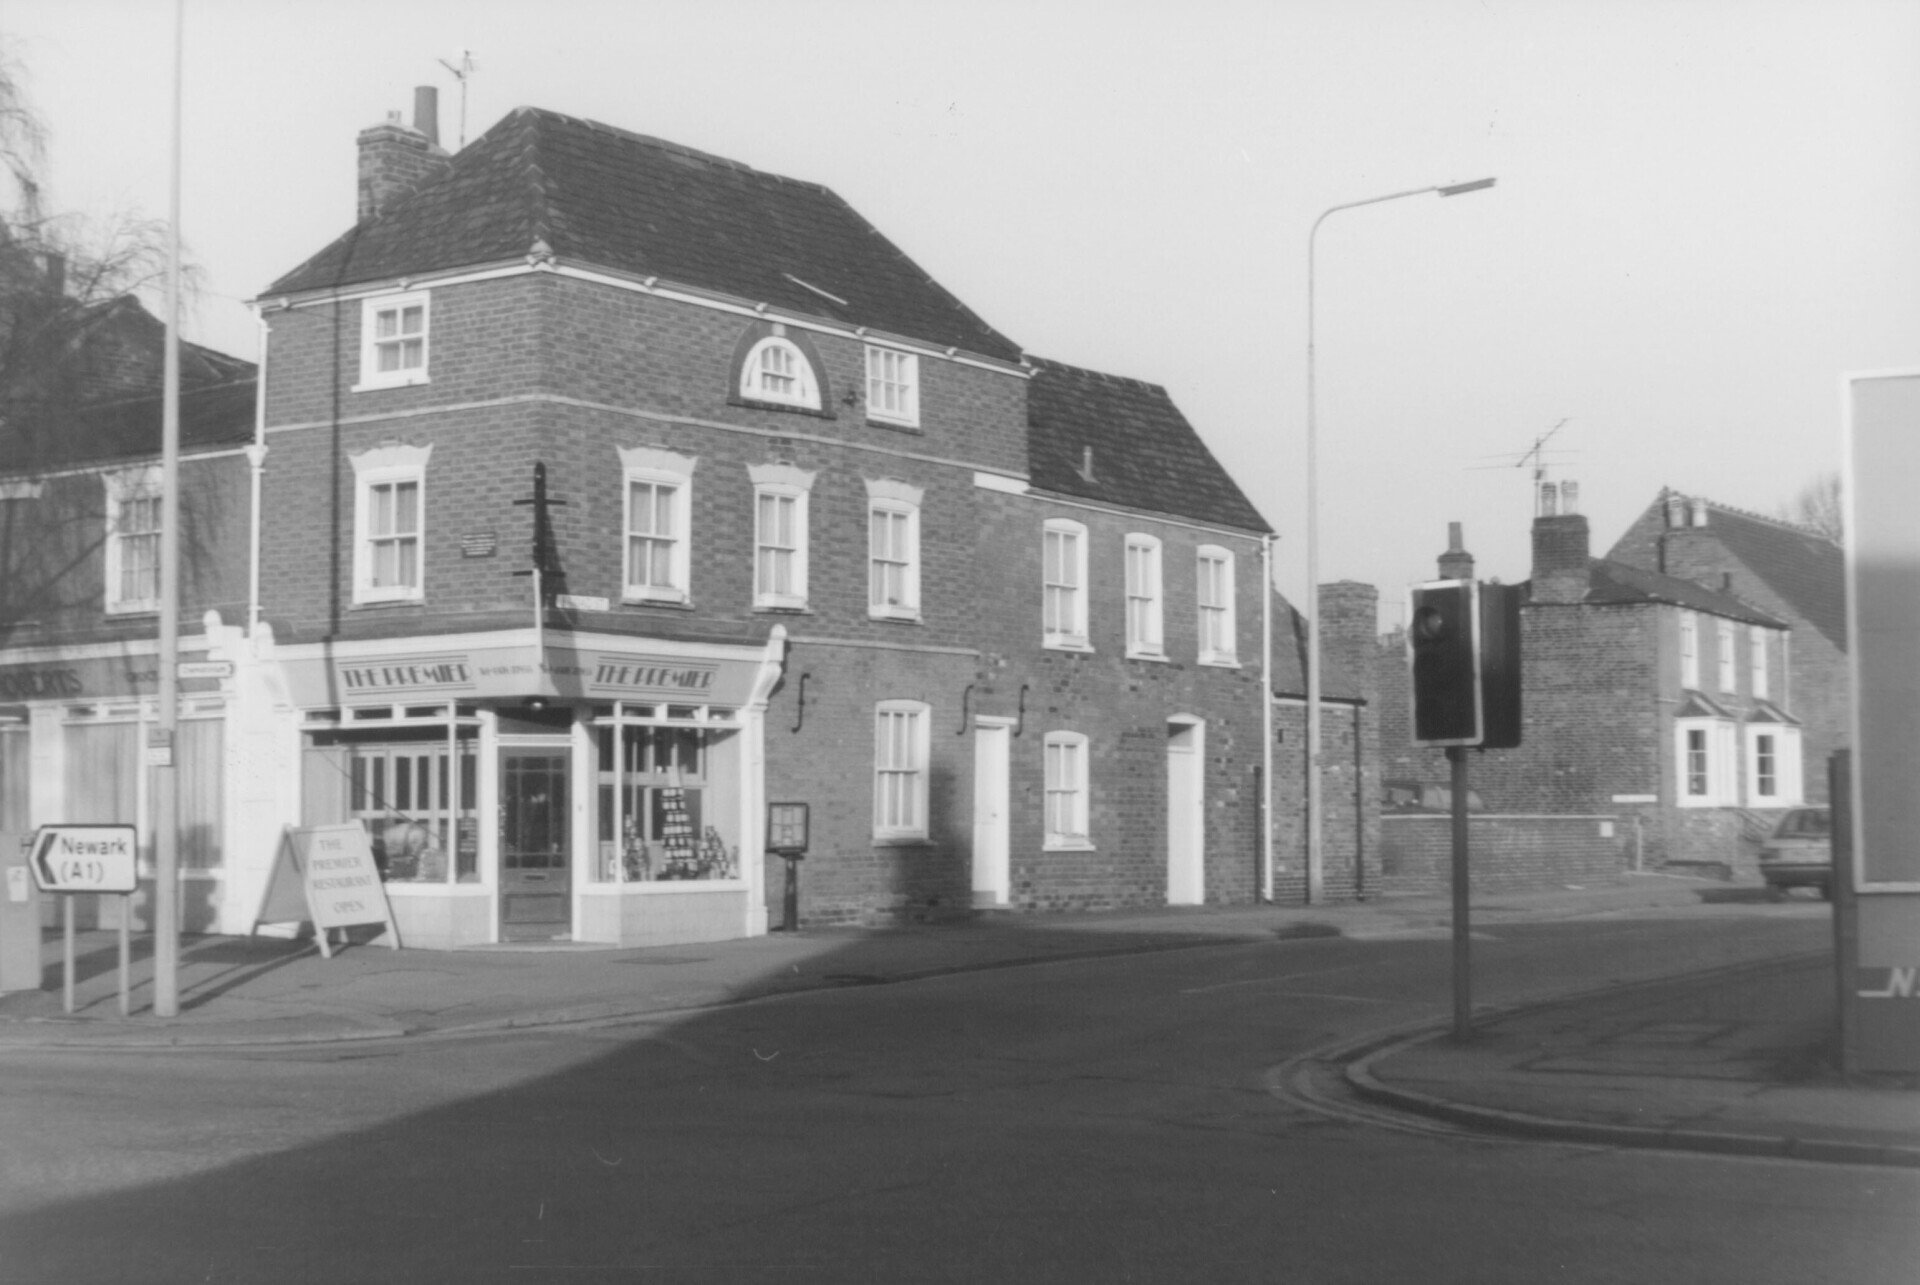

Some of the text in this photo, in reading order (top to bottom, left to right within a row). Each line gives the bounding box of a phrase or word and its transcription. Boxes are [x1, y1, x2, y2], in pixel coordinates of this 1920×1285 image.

[342, 669, 379, 688] THE
[382, 664, 472, 686] PREMIER
[596, 664, 631, 684] THE
[633, 667, 716, 688] PREMIER
[61, 837, 127, 855] Newark
[318, 838, 344, 851] THE
[312, 857, 362, 870] PREMIER
[60, 860, 104, 884] (A1)
[312, 875, 372, 889] RESTAURANT
[333, 901, 365, 914] OPEN
